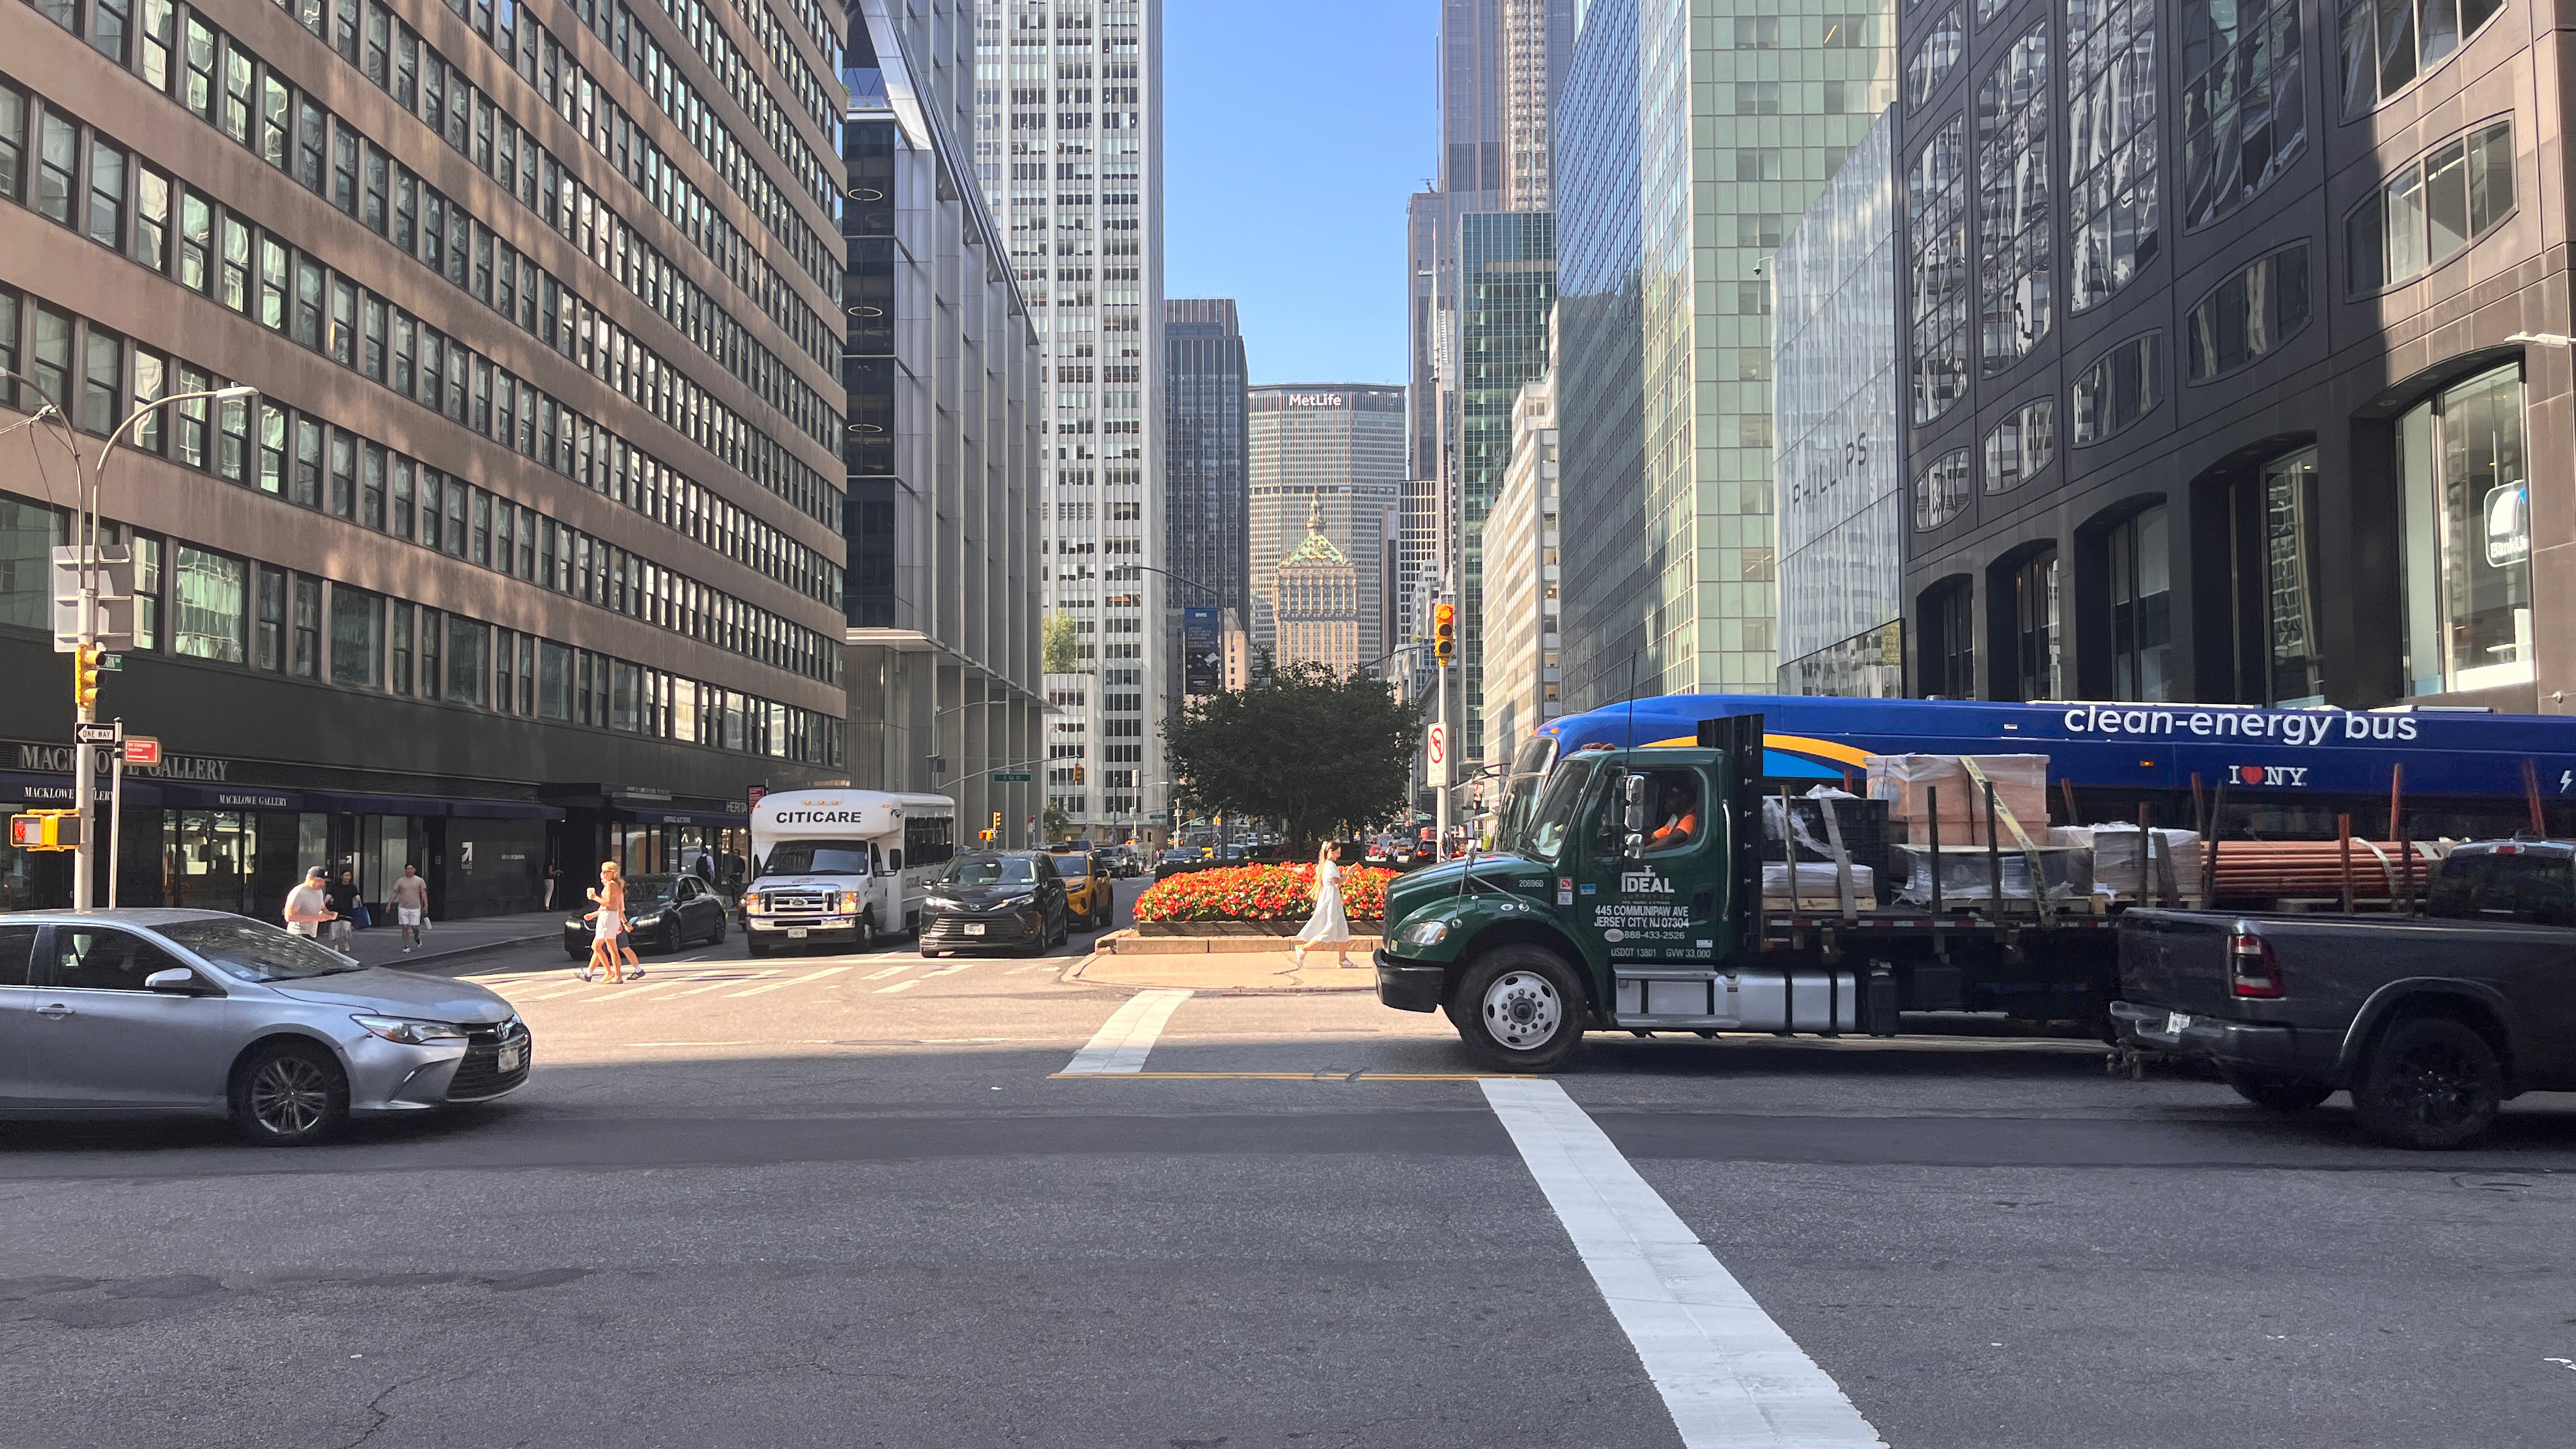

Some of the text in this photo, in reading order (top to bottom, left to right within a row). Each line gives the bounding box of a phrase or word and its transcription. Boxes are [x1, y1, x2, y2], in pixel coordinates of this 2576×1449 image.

[1290, 393, 1342, 406] MetLife
[1793, 432, 1867, 513] PHILLIPS
[104, 656, 115, 668] ARK
[2064, 705, 2417, 746] clean-energy bus
[83, 729, 111, 739] ONE WAY
[2229, 765, 2308, 787] I NY
[24, 786, 74, 800] MACKLOWE
[219, 795, 287, 807] MACKLOWE GALLERY
[726, 801, 748, 813] HERITA
[776, 811, 862, 823] CITICARE
[1519, 879, 1544, 888] 206960
[1621, 876, 1675, 893] IDEAL
[1595, 905, 1689, 917] 445 COMMUNIPAW AVE
[1594, 916, 1689, 929] JERSEY CITY, NJ 07304
[1611, 948, 1711, 958] USDOT 13801 GVW 33,000
